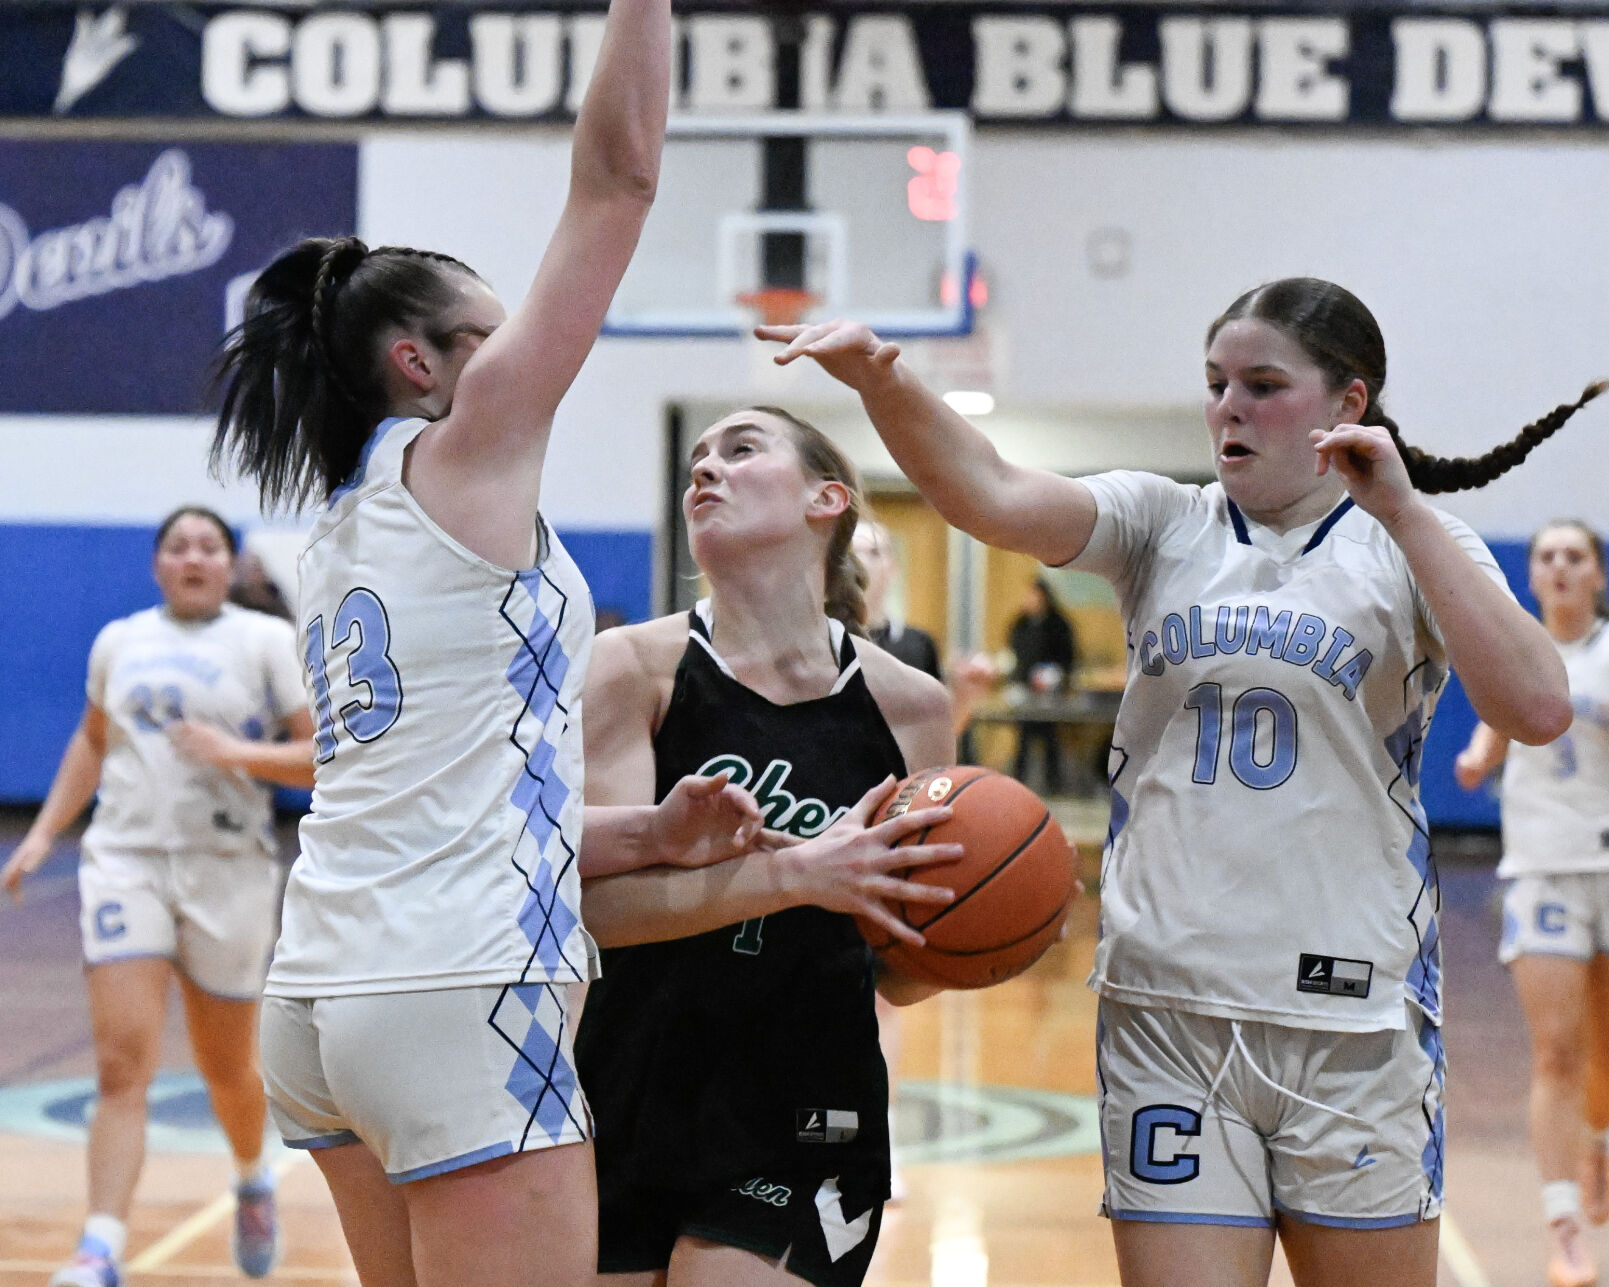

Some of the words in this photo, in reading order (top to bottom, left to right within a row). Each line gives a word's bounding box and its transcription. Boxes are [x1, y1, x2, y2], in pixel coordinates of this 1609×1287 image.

[971, 15, 1351, 122] BLUE
[1390, 16, 1609, 121] DE
[0, 148, 235, 320] evils
[304, 587, 403, 764] 13
[1140, 604, 1374, 701] COLUMBIA
[1184, 682, 1298, 790] 10
[696, 753, 851, 838] he
[93, 900, 126, 941] C
[1535, 901, 1567, 936] C
[1343, 981, 1356, 992] M
[1129, 1104, 1202, 1185] C
